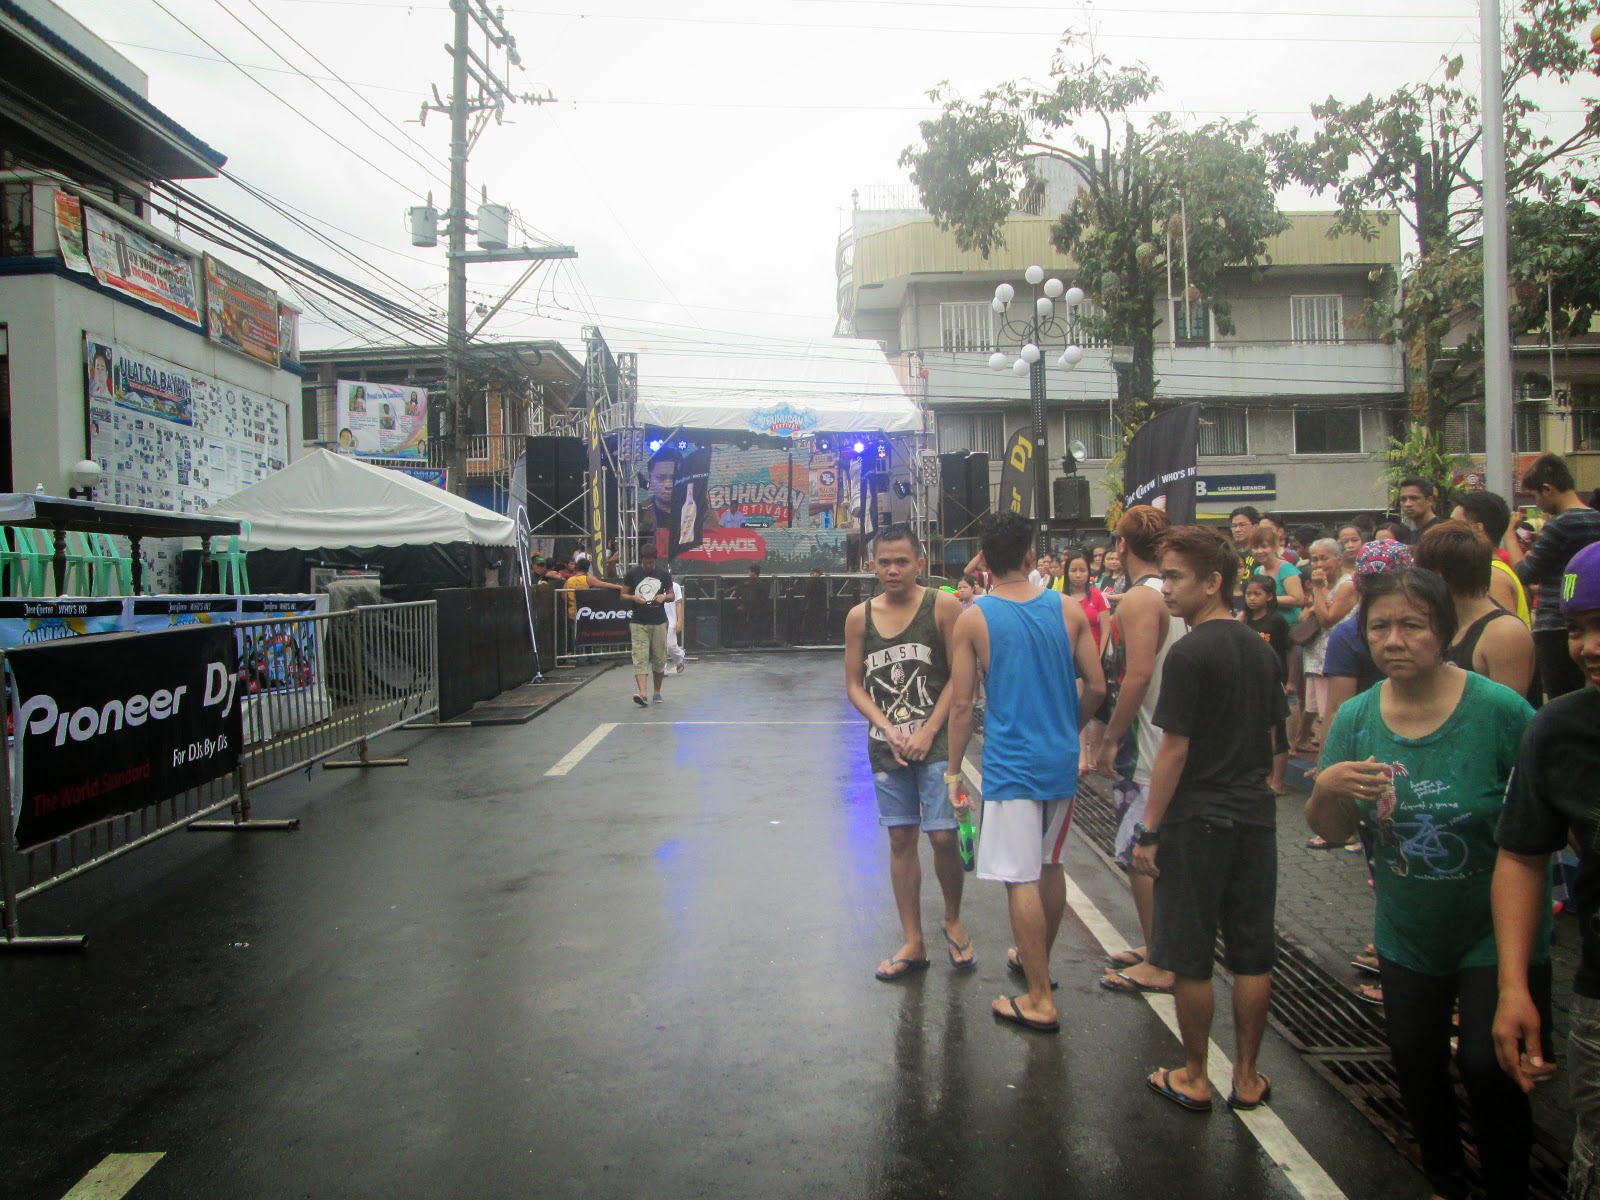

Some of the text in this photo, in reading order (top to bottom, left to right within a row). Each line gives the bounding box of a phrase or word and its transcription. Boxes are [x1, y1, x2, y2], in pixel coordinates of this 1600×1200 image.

[119, 356, 145, 382] ULAT
[145, 366, 158, 386] SA
[765, 414, 804, 425] BUHUSAN
[1010, 435, 1033, 473] DJ
[1161, 469, 1186, 484] WHO'S
[708, 482, 806, 511] BUHUSAN
[58, 603, 78, 615] WHO'S
[78, 602, 88, 615] IN?
[872, 644, 918, 667] LAST
[19, 661, 238, 747] Pioneer DJ
[173, 748, 186, 768] For
[204, 738, 217, 760] By
[32, 793, 58, 817] The
[58, 776, 100, 807] World
